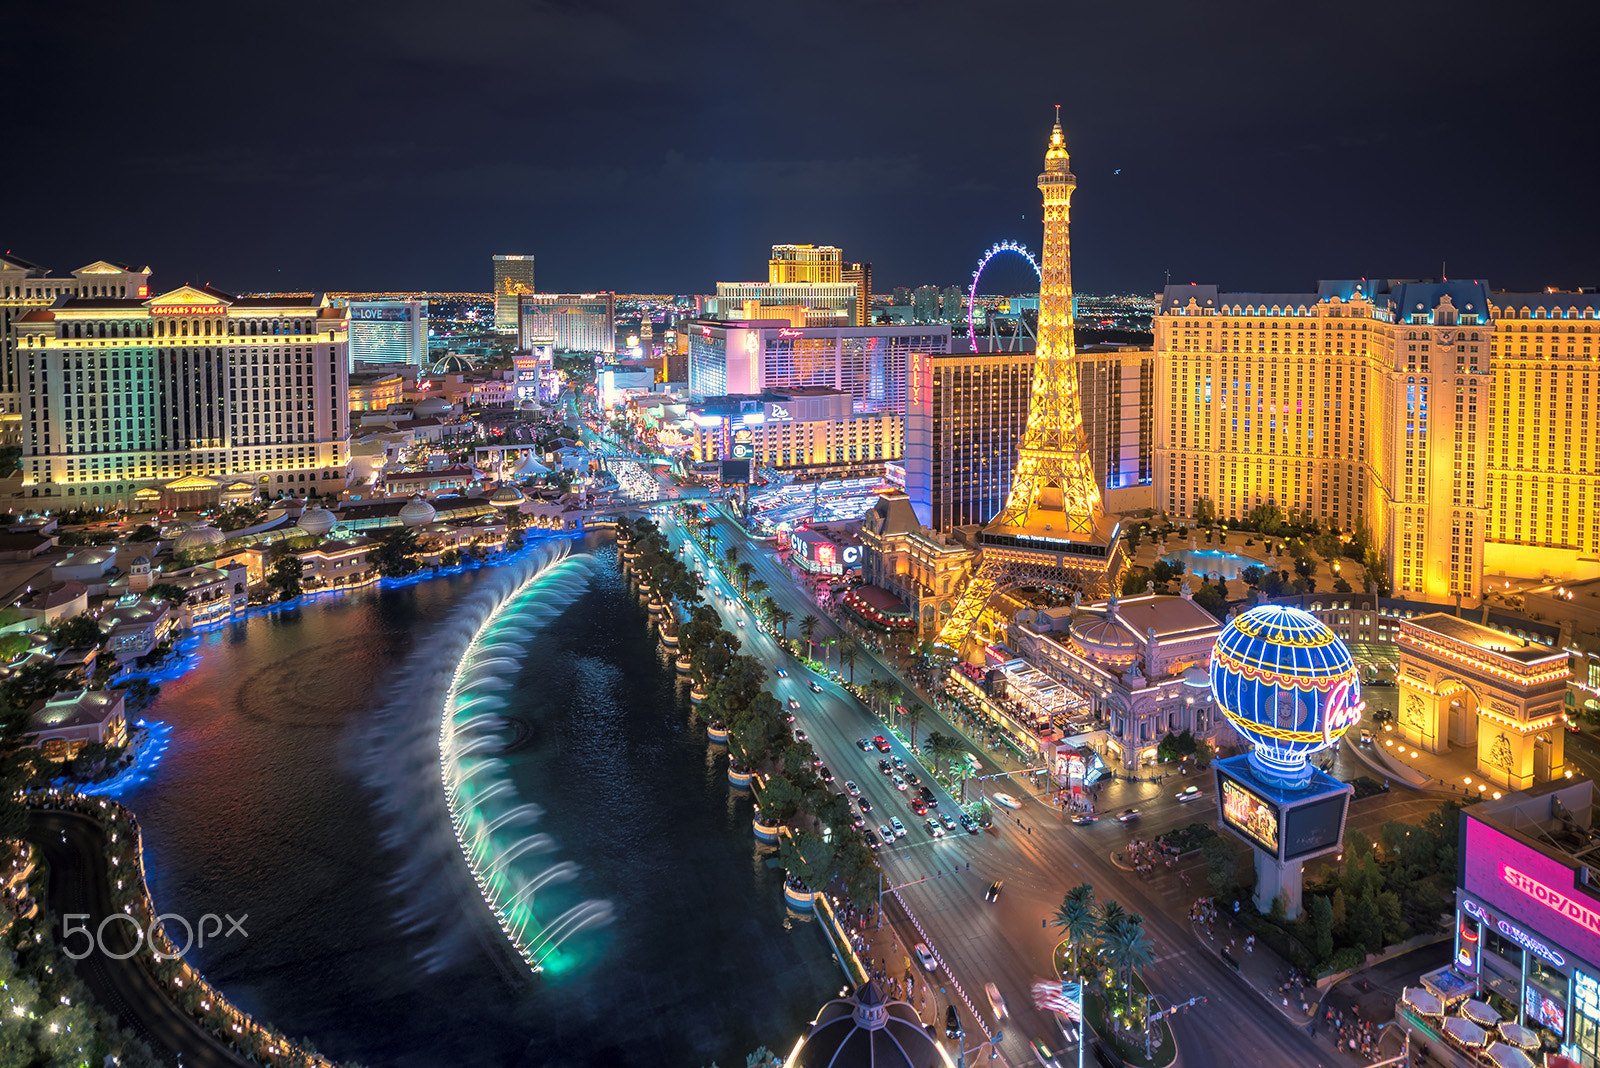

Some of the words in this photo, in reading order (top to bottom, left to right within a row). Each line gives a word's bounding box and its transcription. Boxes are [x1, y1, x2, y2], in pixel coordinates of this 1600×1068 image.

[152, 306, 189, 315] CAESARS
[191, 306, 224, 315] PALACE
[361, 309, 383, 319] LOVE
[791, 533, 808, 558] CVS
[1325, 680, 1366, 746] Paris
